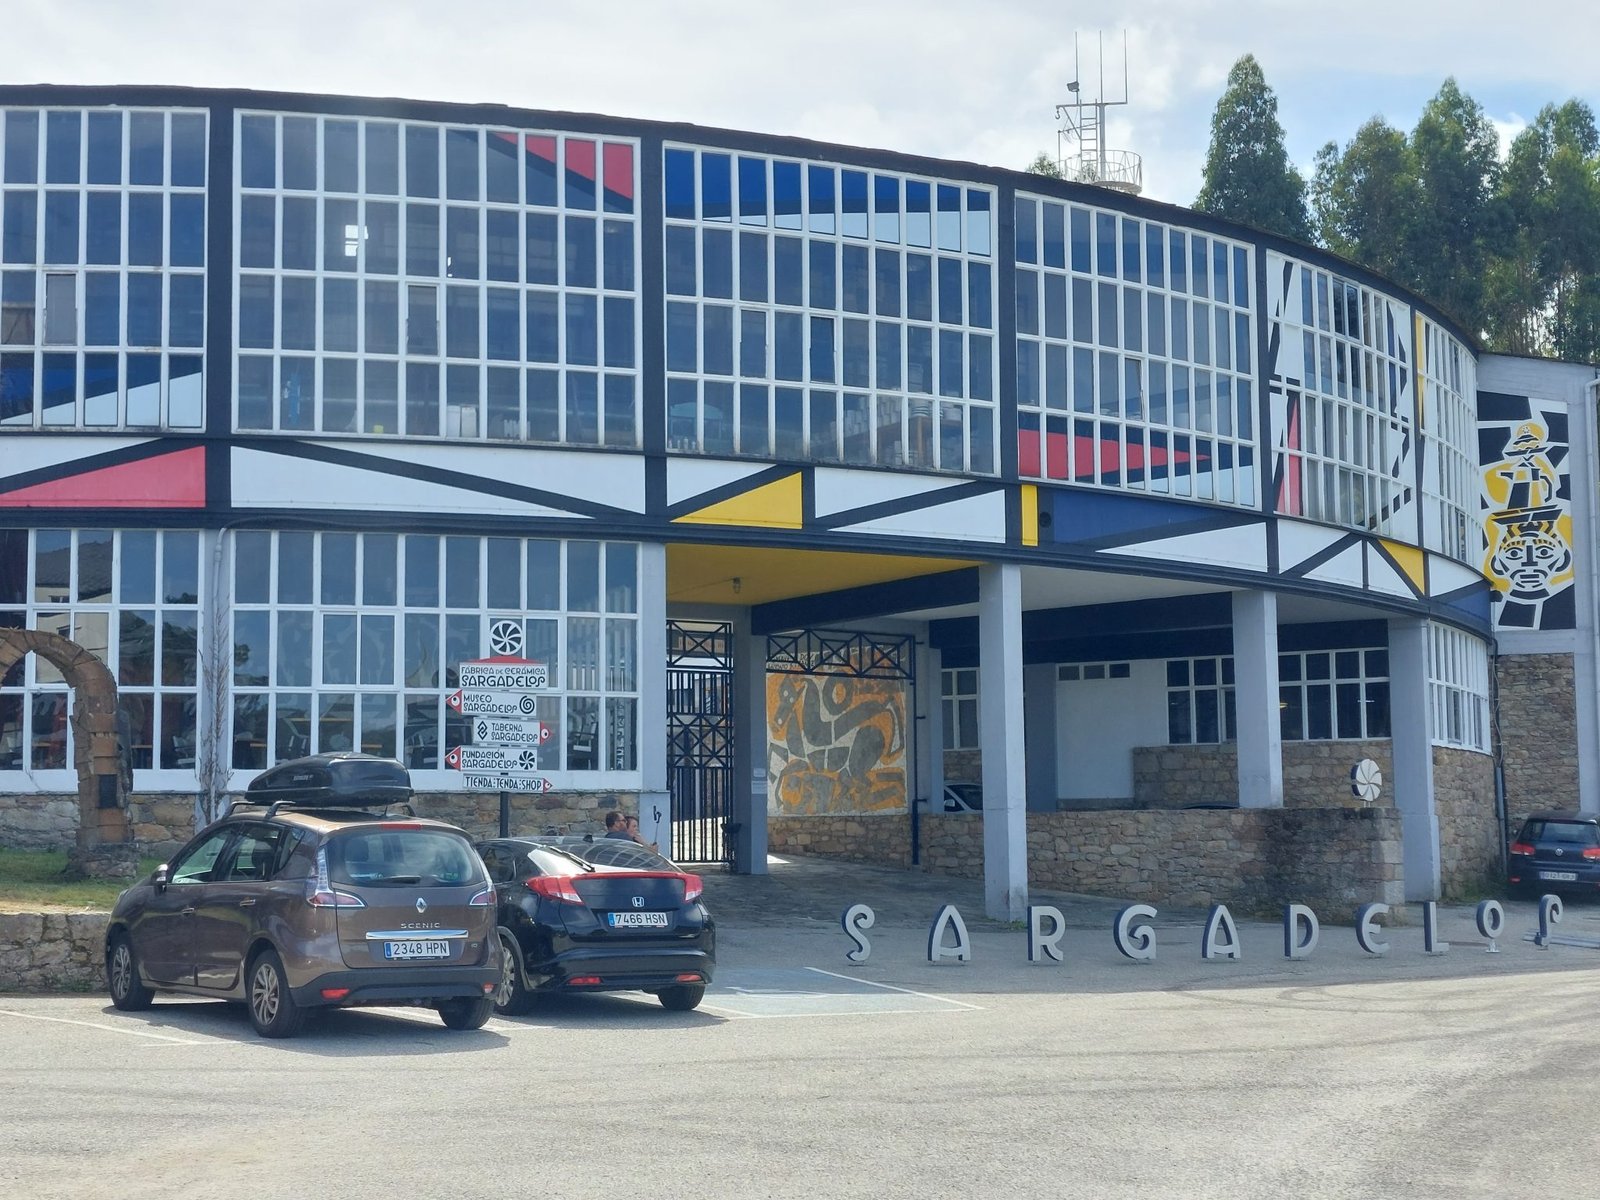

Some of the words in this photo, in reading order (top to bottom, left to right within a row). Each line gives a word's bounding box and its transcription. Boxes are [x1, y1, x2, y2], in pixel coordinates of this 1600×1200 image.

[461, 666, 495, 675] FÁBRICA
[504, 666, 546, 676] CERÁMICA
[461, 674, 546, 688] SARGADELOS
[463, 694, 493, 703] MUSEO
[463, 702, 518, 714] SARGADELOS
[491, 722, 523, 733] TABERNA
[491, 731, 539, 743] SARGADELOS
[461, 748, 505, 760] FUNDACIÓN
[461, 759, 518, 770] SARGADELOS
[521, 779, 542, 791] SHOP
[615, 913, 643, 924] 7466
[644, 914, 665, 924] HSN
[841, 892, 1564, 963] SARGADELOS
[393, 942, 423, 955] 2348
[426, 941, 447, 954] HPN
